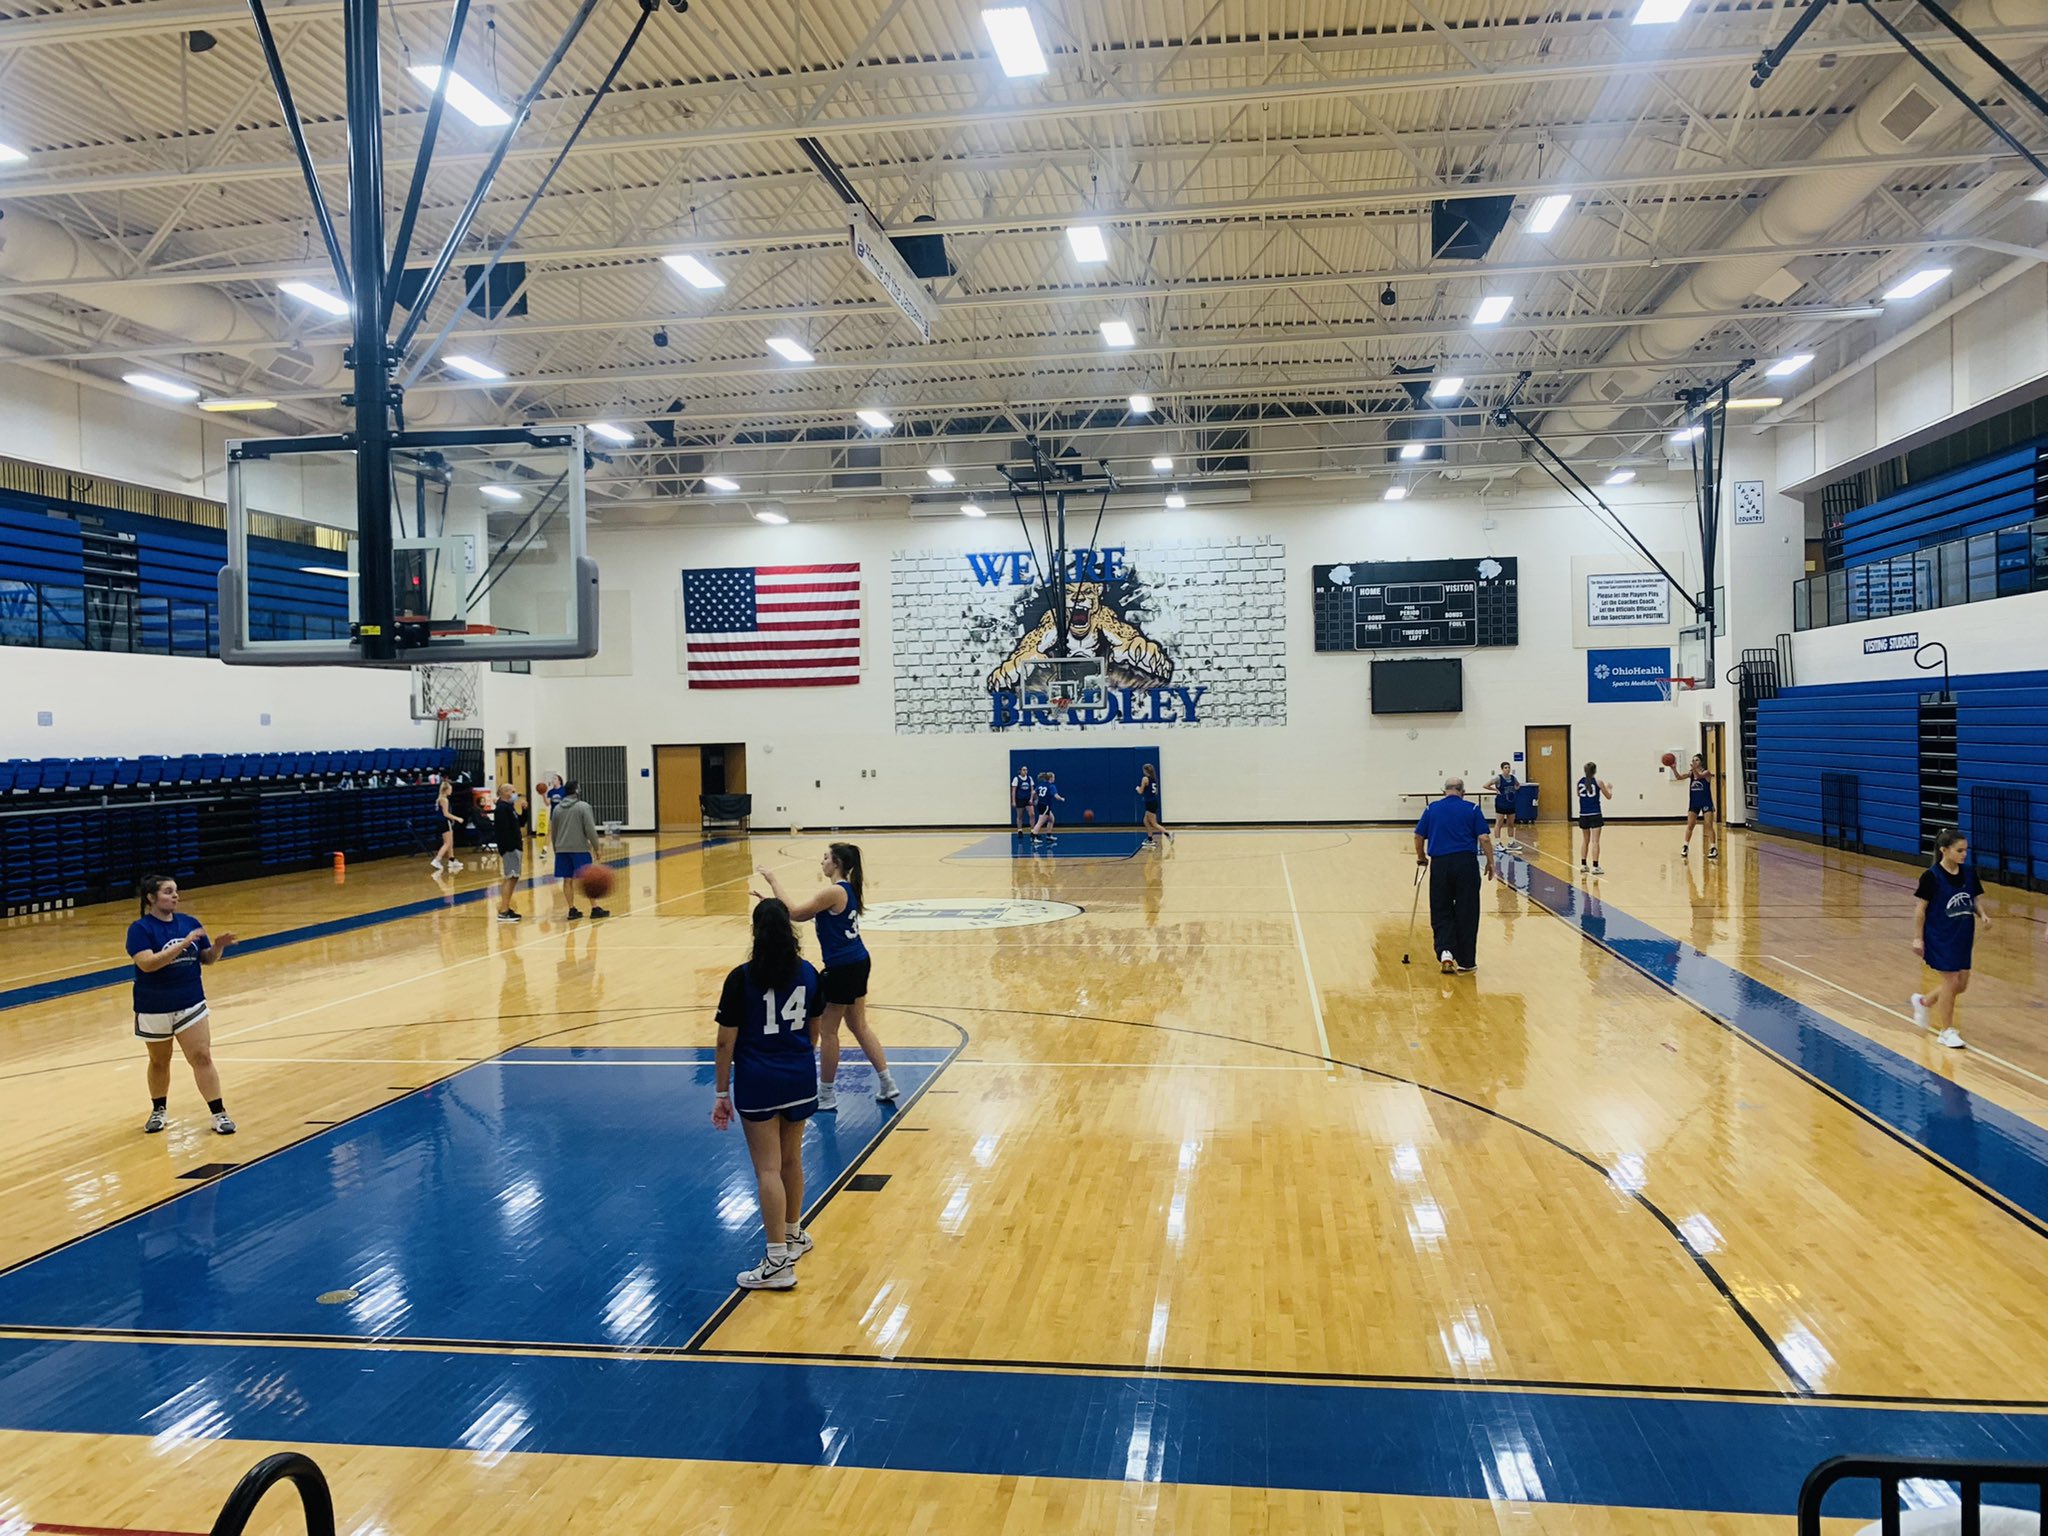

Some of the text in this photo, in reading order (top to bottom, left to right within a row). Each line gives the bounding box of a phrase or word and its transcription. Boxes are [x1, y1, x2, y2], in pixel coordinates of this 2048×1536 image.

[965, 552, 1035, 587] WE
[1359, 587, 1382, 596] HOME
[1445, 584, 1474, 592] VISITOR
[1865, 635, 1917, 652] VISITING STUDENTS
[1612, 666, 1664, 675] OhioHealth
[990, 687, 1207, 727] BRADLEY
[1579, 783, 1596, 797] 20
[763, 986, 807, 1034] 14
